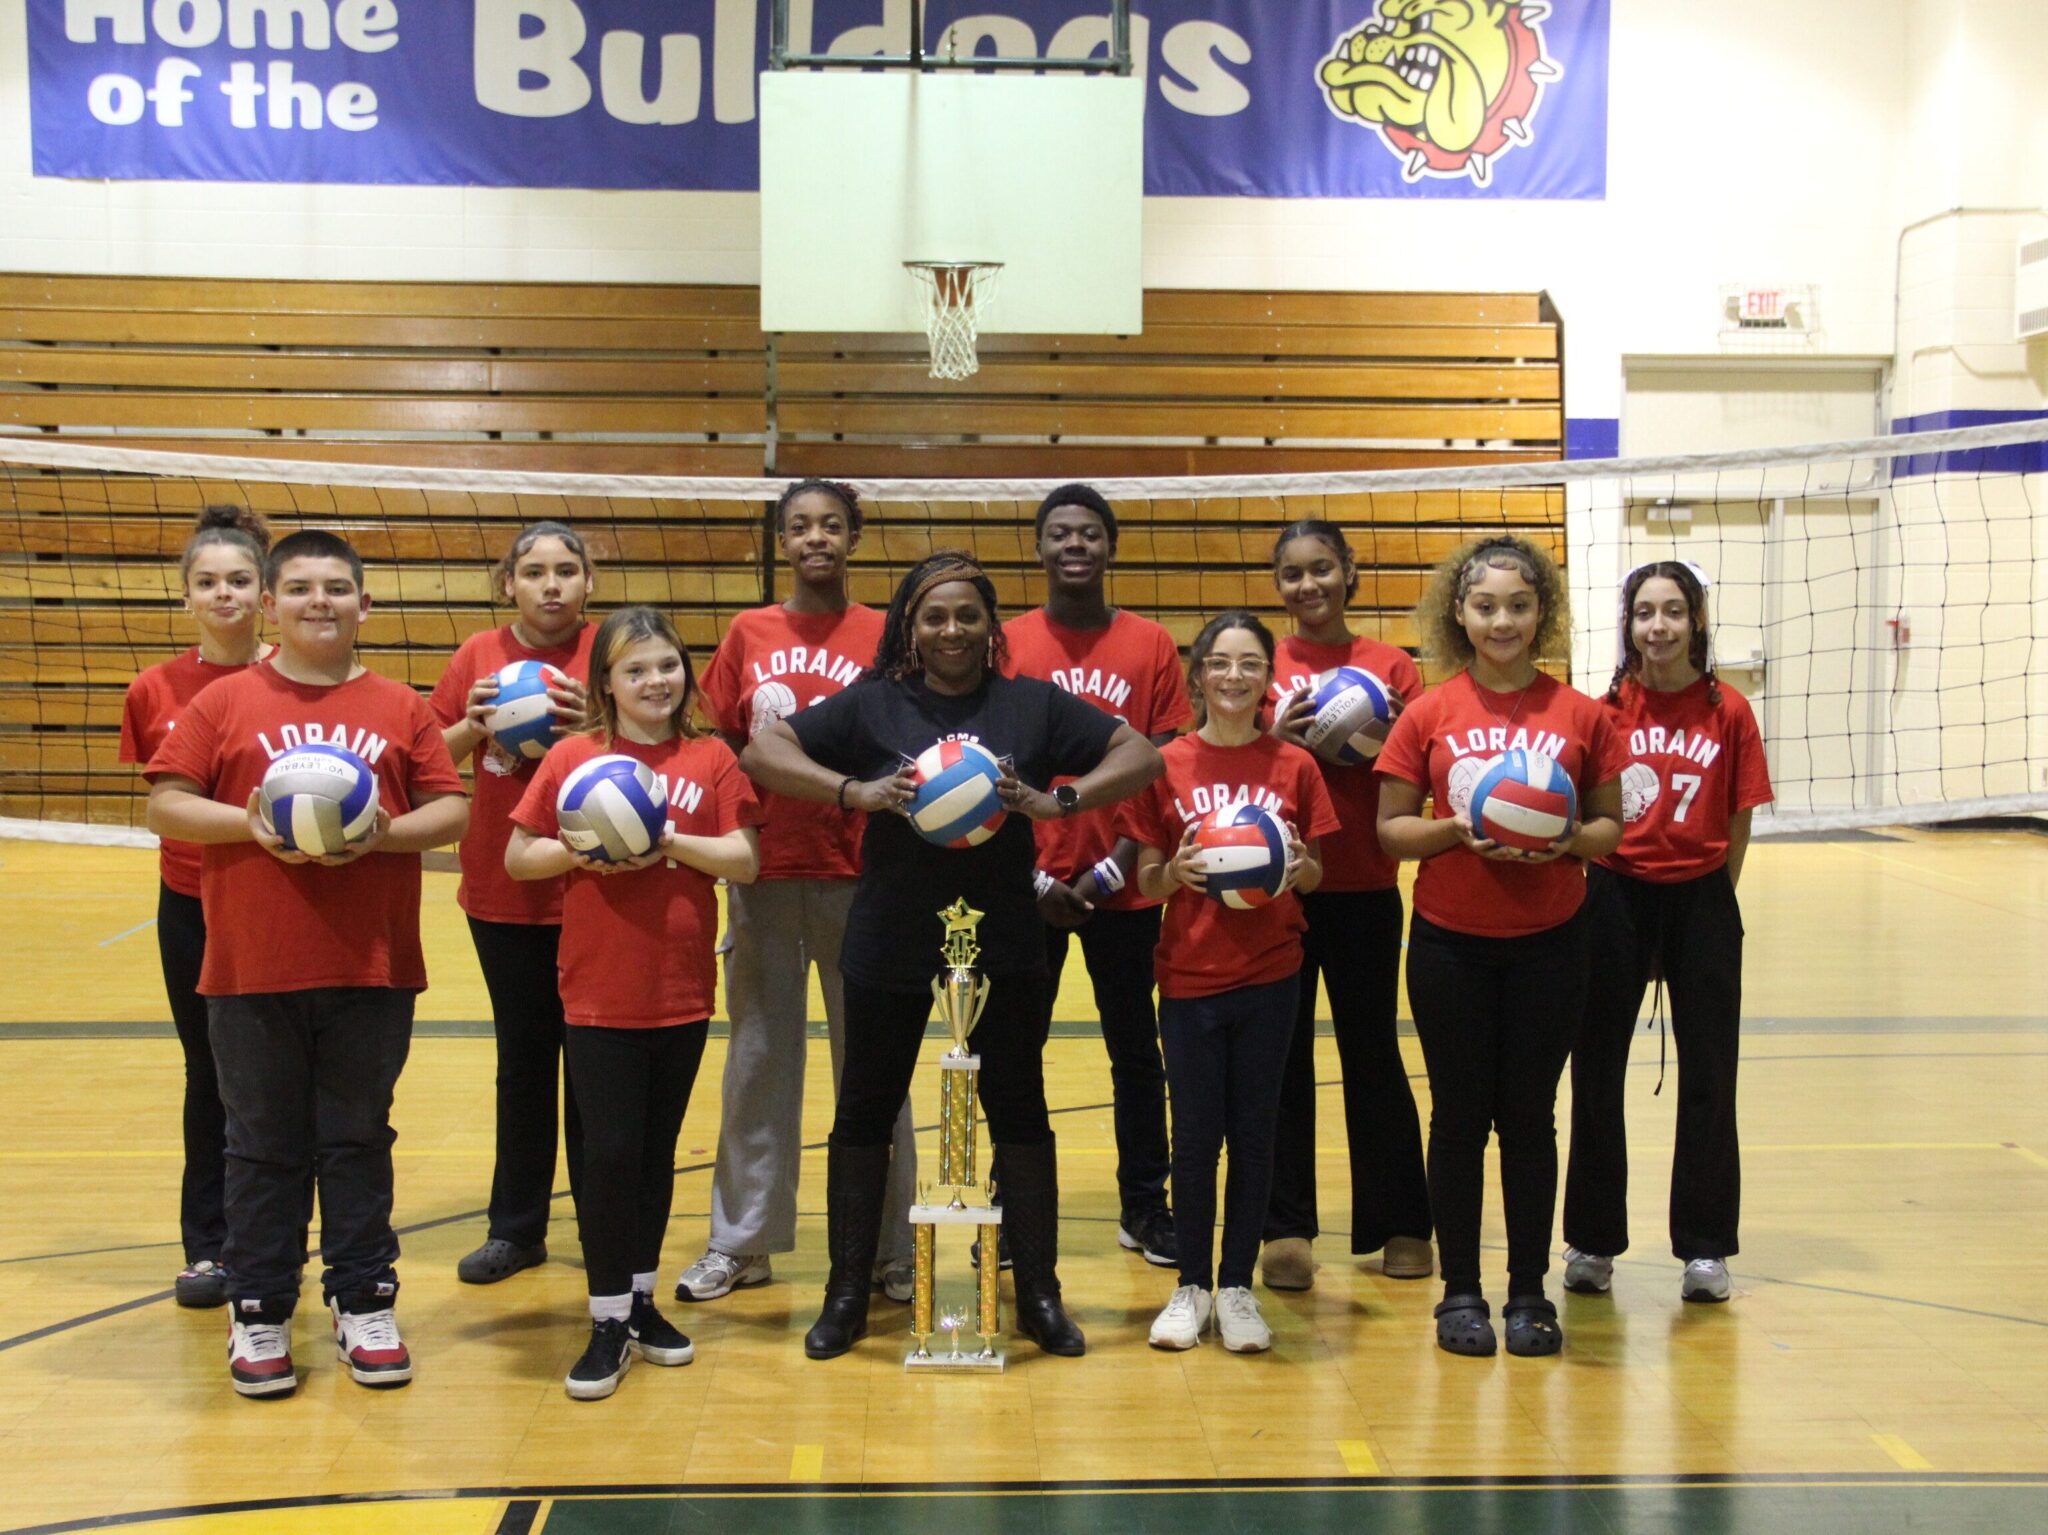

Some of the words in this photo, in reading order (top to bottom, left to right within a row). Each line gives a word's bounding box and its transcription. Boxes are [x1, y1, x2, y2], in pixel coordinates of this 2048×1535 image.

[87, 57, 202, 126] of
[219, 60, 379, 132] the
[1748, 292, 1778, 315] EXIT
[753, 646, 862, 687] LORAIN
[1051, 667, 1132, 708] ORAIN
[257, 723, 388, 765] LORAIN
[1446, 728, 1566, 760] LORAIN
[1630, 726, 1720, 768] ORAIN
[1174, 784, 1283, 823] LORAIN
[1671, 774, 1702, 823] 7
